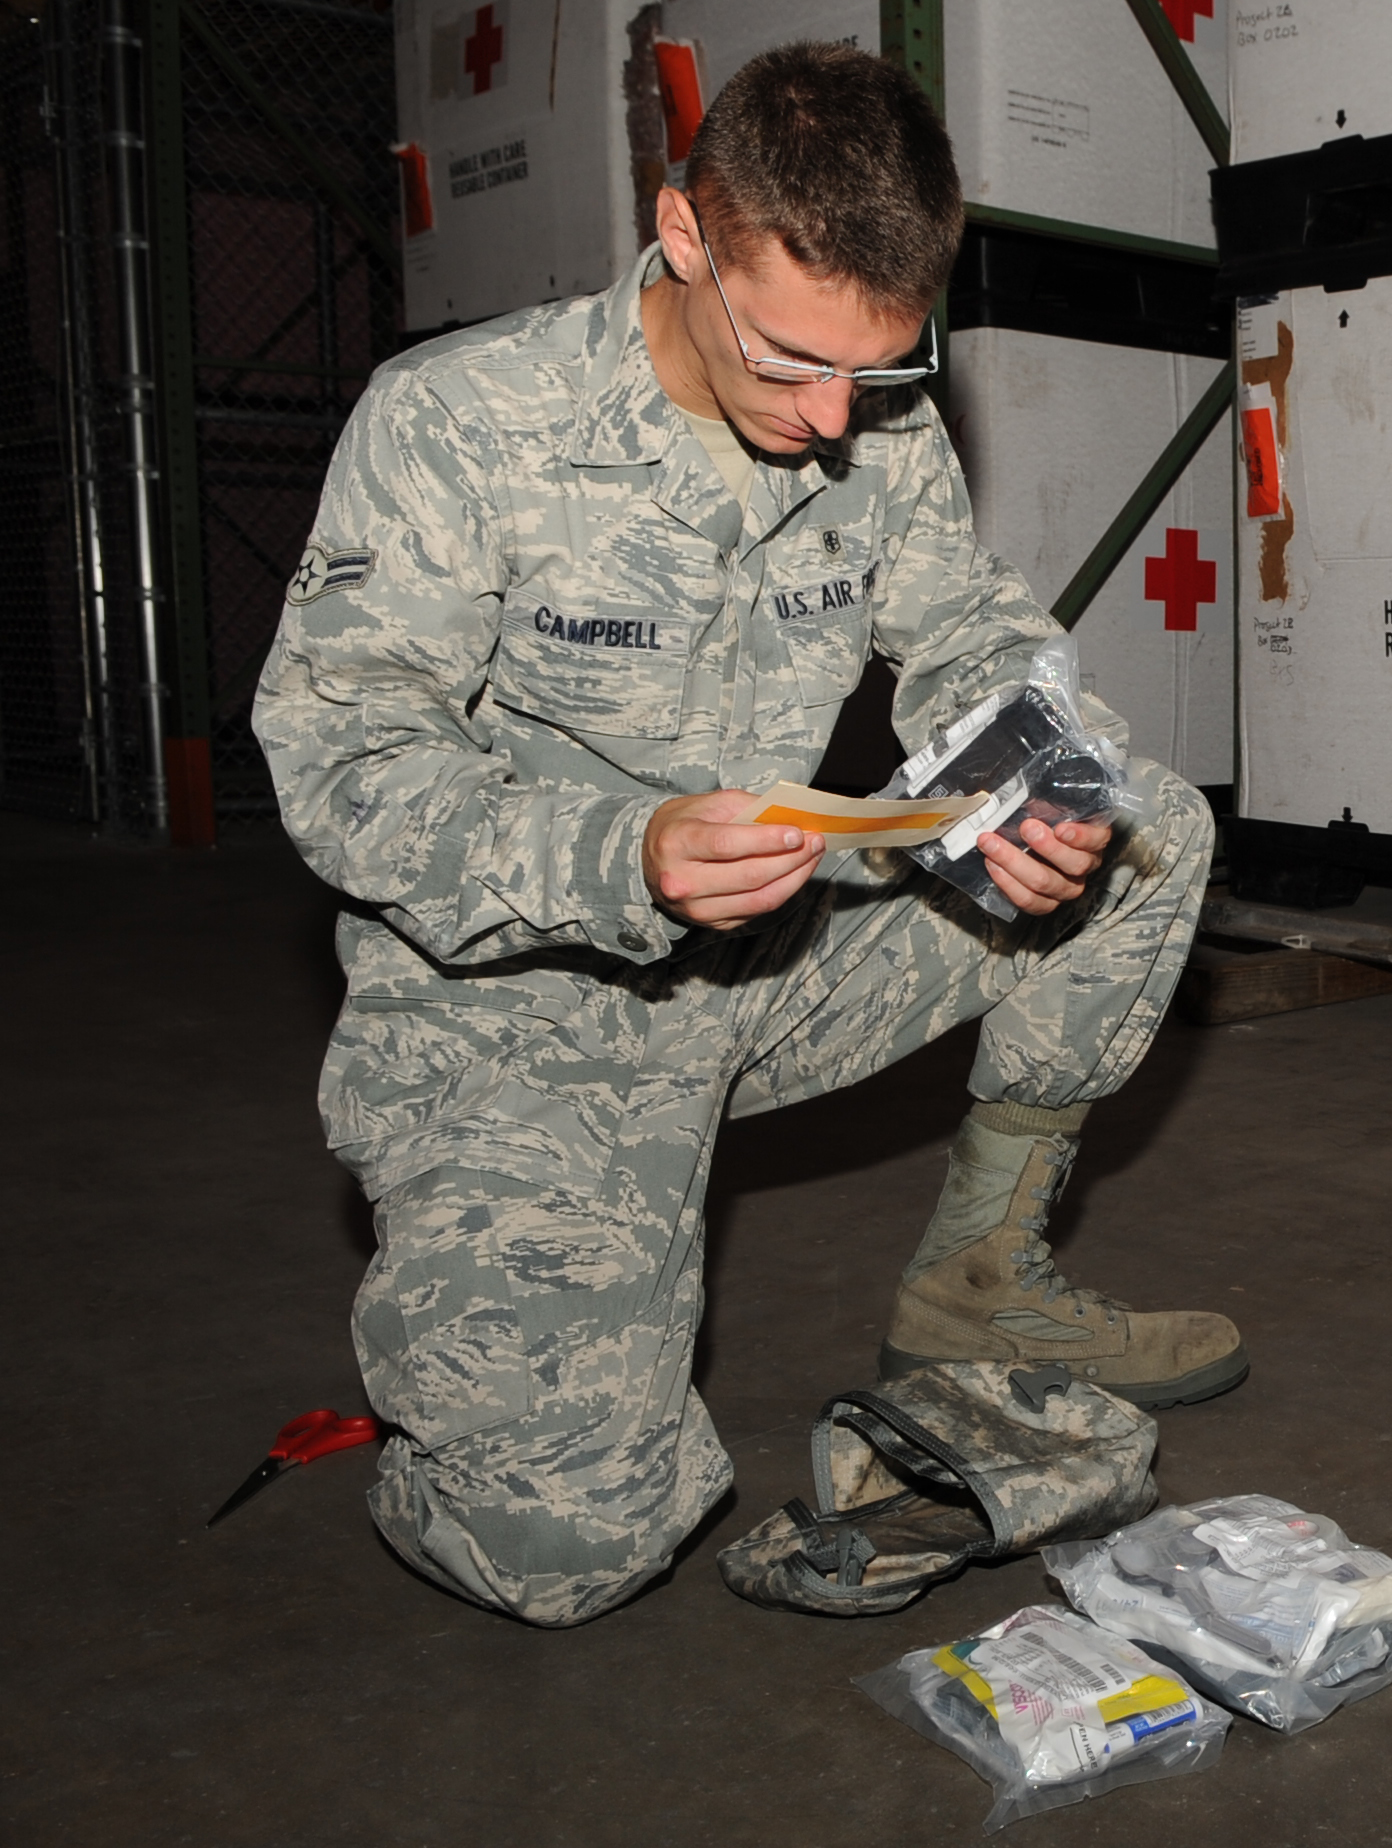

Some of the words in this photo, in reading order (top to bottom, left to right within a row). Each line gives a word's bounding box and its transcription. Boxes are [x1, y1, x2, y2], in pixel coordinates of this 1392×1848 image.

[774, 591, 814, 620] U.S.
[822, 580, 855, 611] AIR
[534, 606, 661, 649] CAMPBELL
